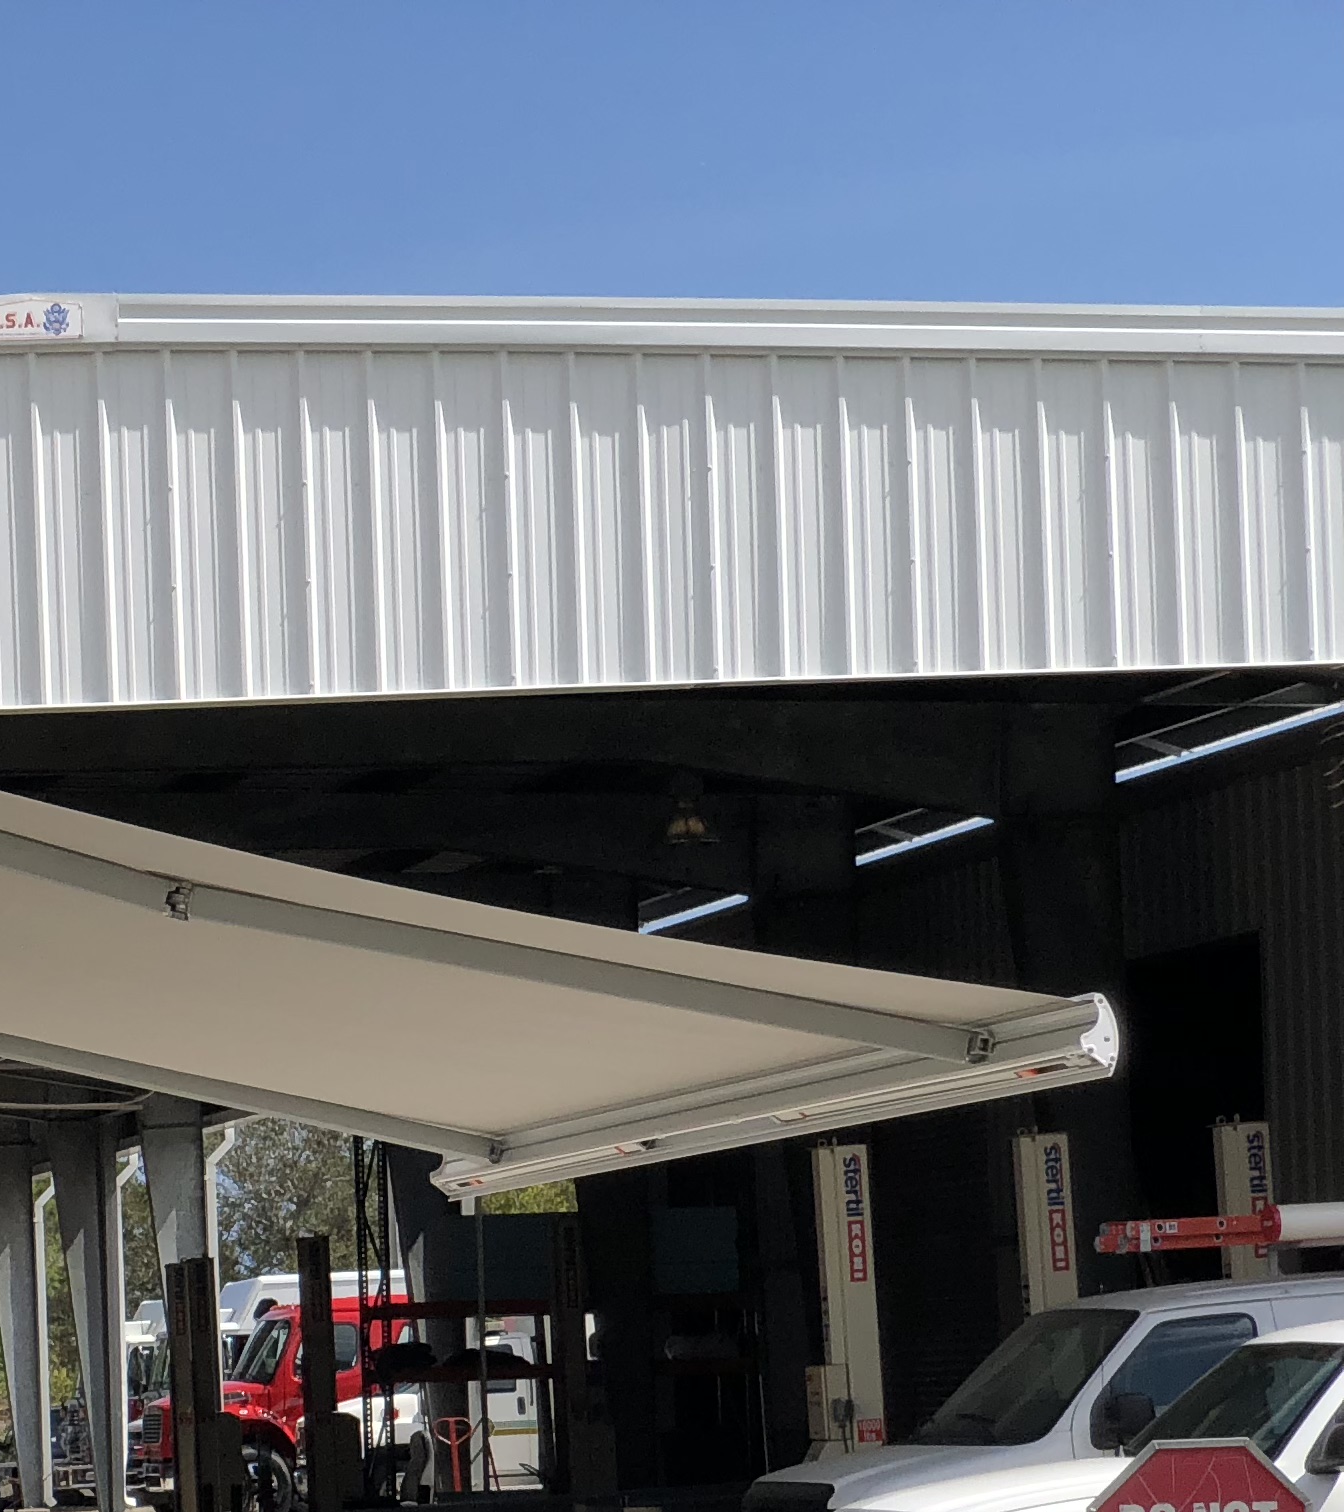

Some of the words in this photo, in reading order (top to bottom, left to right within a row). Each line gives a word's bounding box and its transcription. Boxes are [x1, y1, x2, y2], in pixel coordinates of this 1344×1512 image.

[843, 1155, 864, 1218] stertil
[1044, 1145, 1065, 1207] stertil
[850, 1222, 866, 1280] KONI
